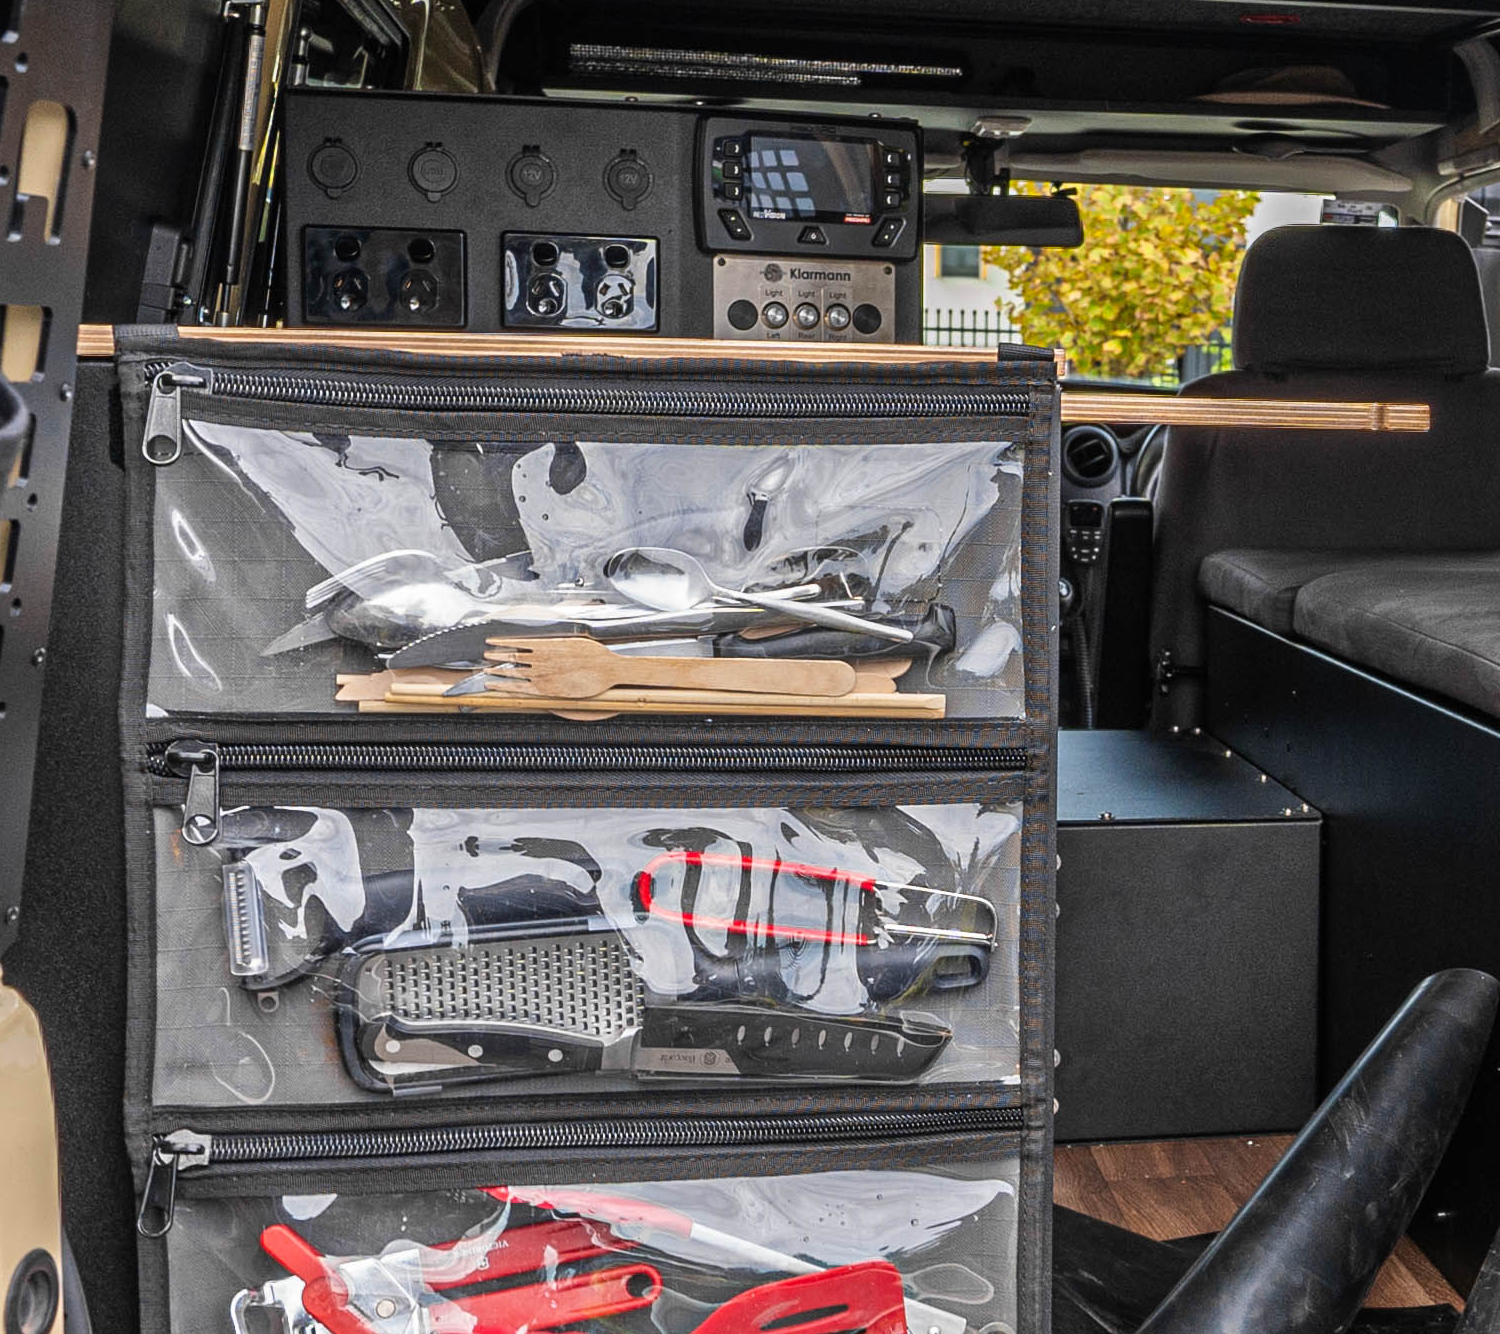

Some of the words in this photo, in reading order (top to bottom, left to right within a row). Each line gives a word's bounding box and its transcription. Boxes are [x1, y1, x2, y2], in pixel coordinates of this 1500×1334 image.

[790, 268, 851, 282] Klarmann
[765, 289, 783, 298] Light
[798, 290, 816, 299] Light
[829, 291, 847, 300] Light
